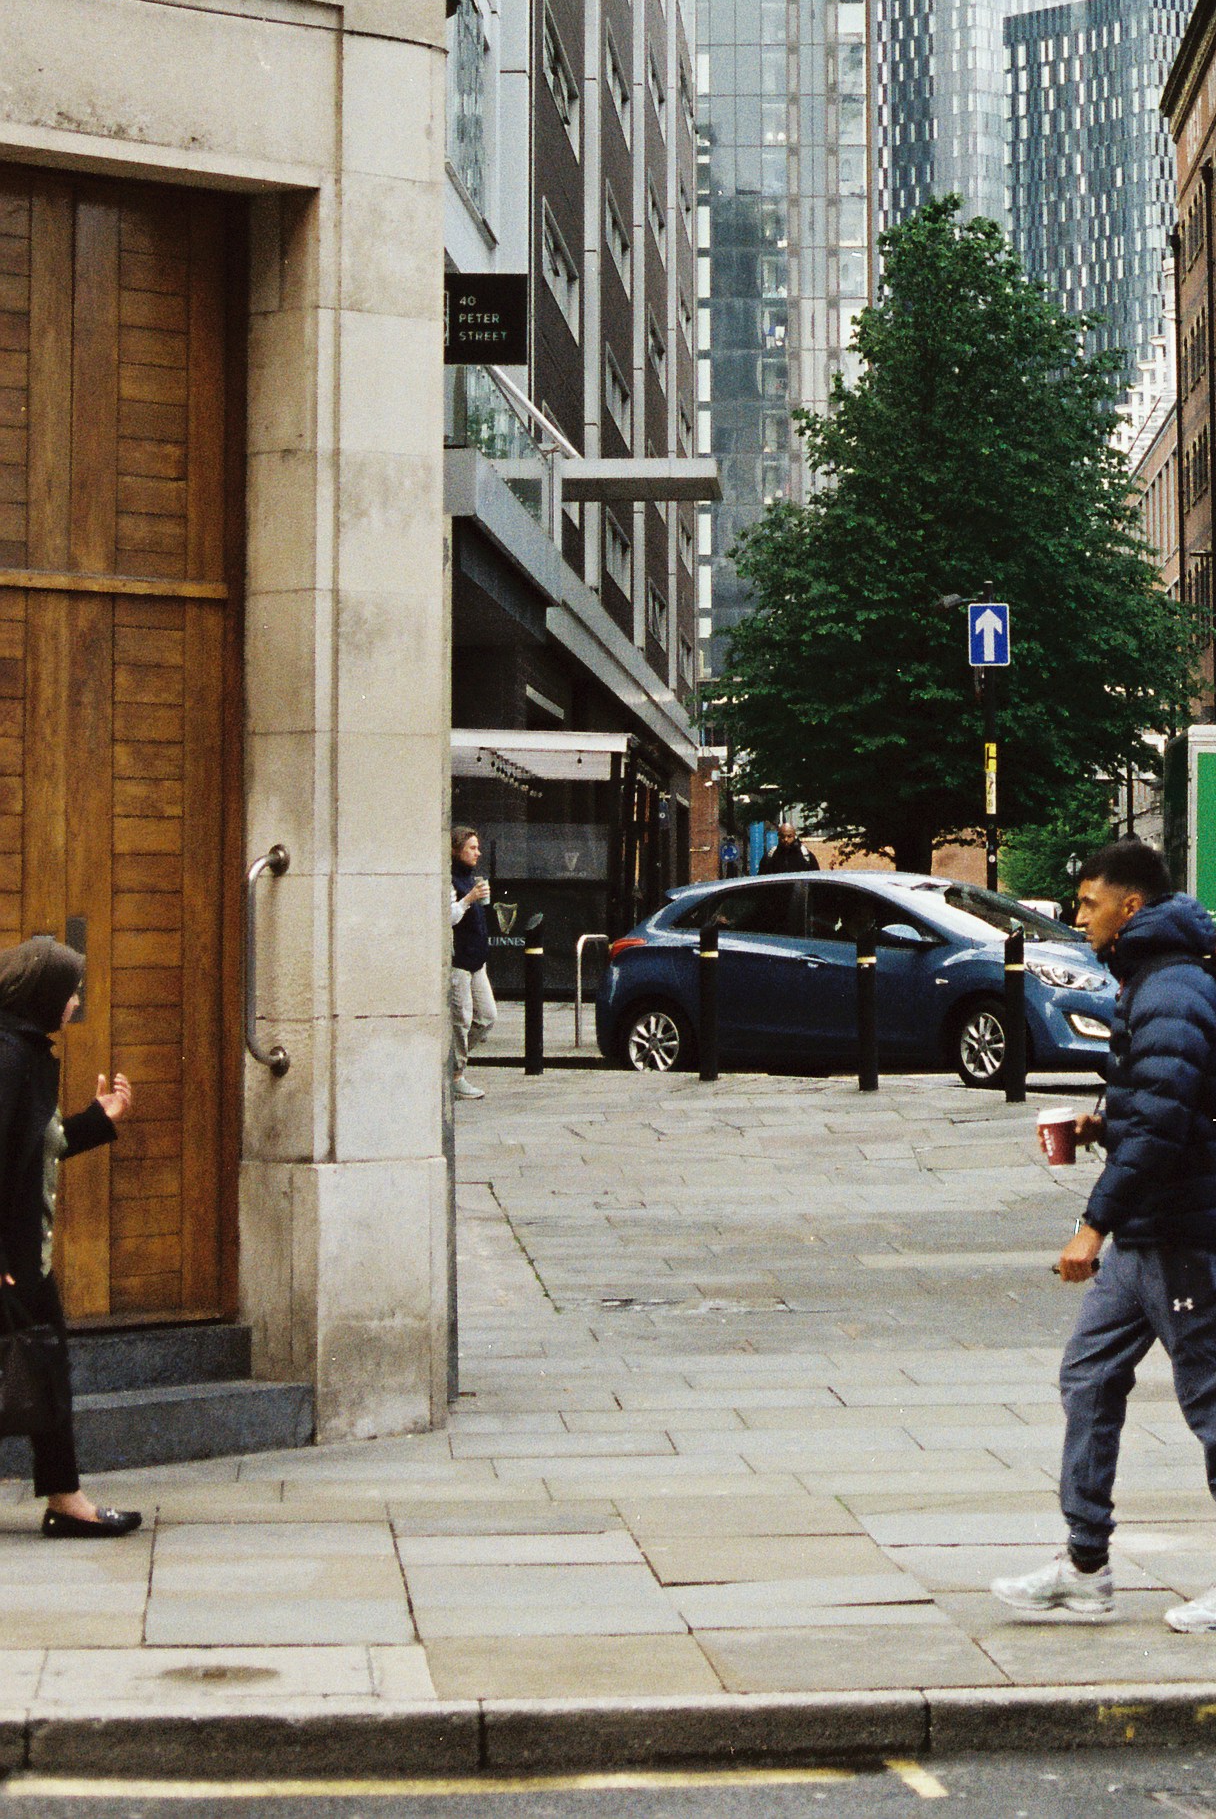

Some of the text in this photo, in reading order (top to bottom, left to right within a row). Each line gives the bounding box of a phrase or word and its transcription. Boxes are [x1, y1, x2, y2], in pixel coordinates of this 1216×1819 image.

[459, 295, 477, 306] 40
[458, 313, 500, 324] PETER
[459, 331, 507, 341] STREET
[487, 936, 526, 946] UINNES
